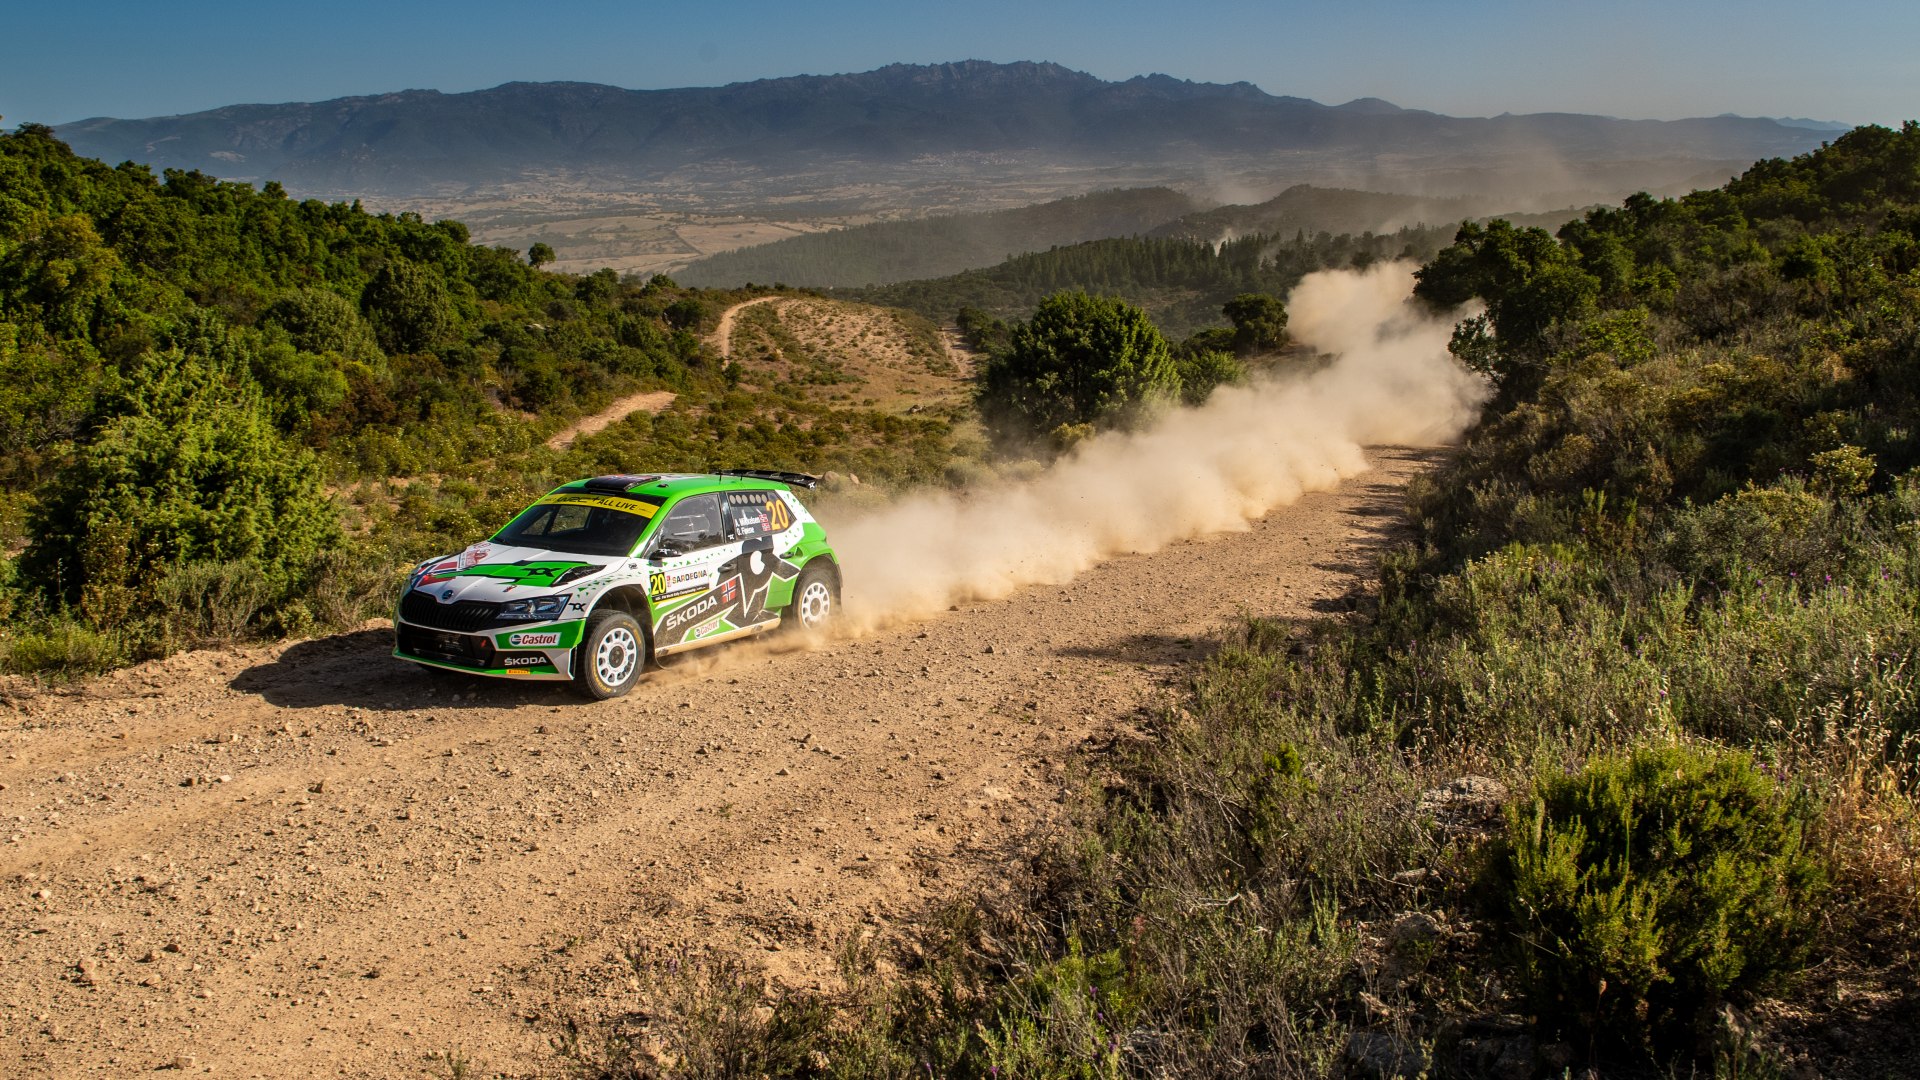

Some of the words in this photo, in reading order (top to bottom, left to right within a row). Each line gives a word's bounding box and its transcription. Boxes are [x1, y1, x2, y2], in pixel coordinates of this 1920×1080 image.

[615, 501, 638, 511] LIVE
[766, 500, 789, 530] 20
[672, 569, 707, 584] SARDEGNA
[651, 574, 666, 595] 20
[666, 596, 718, 631] ŠKODA
[522, 634, 557, 644] Castrol
[504, 656, 547, 666] ŠKODA
